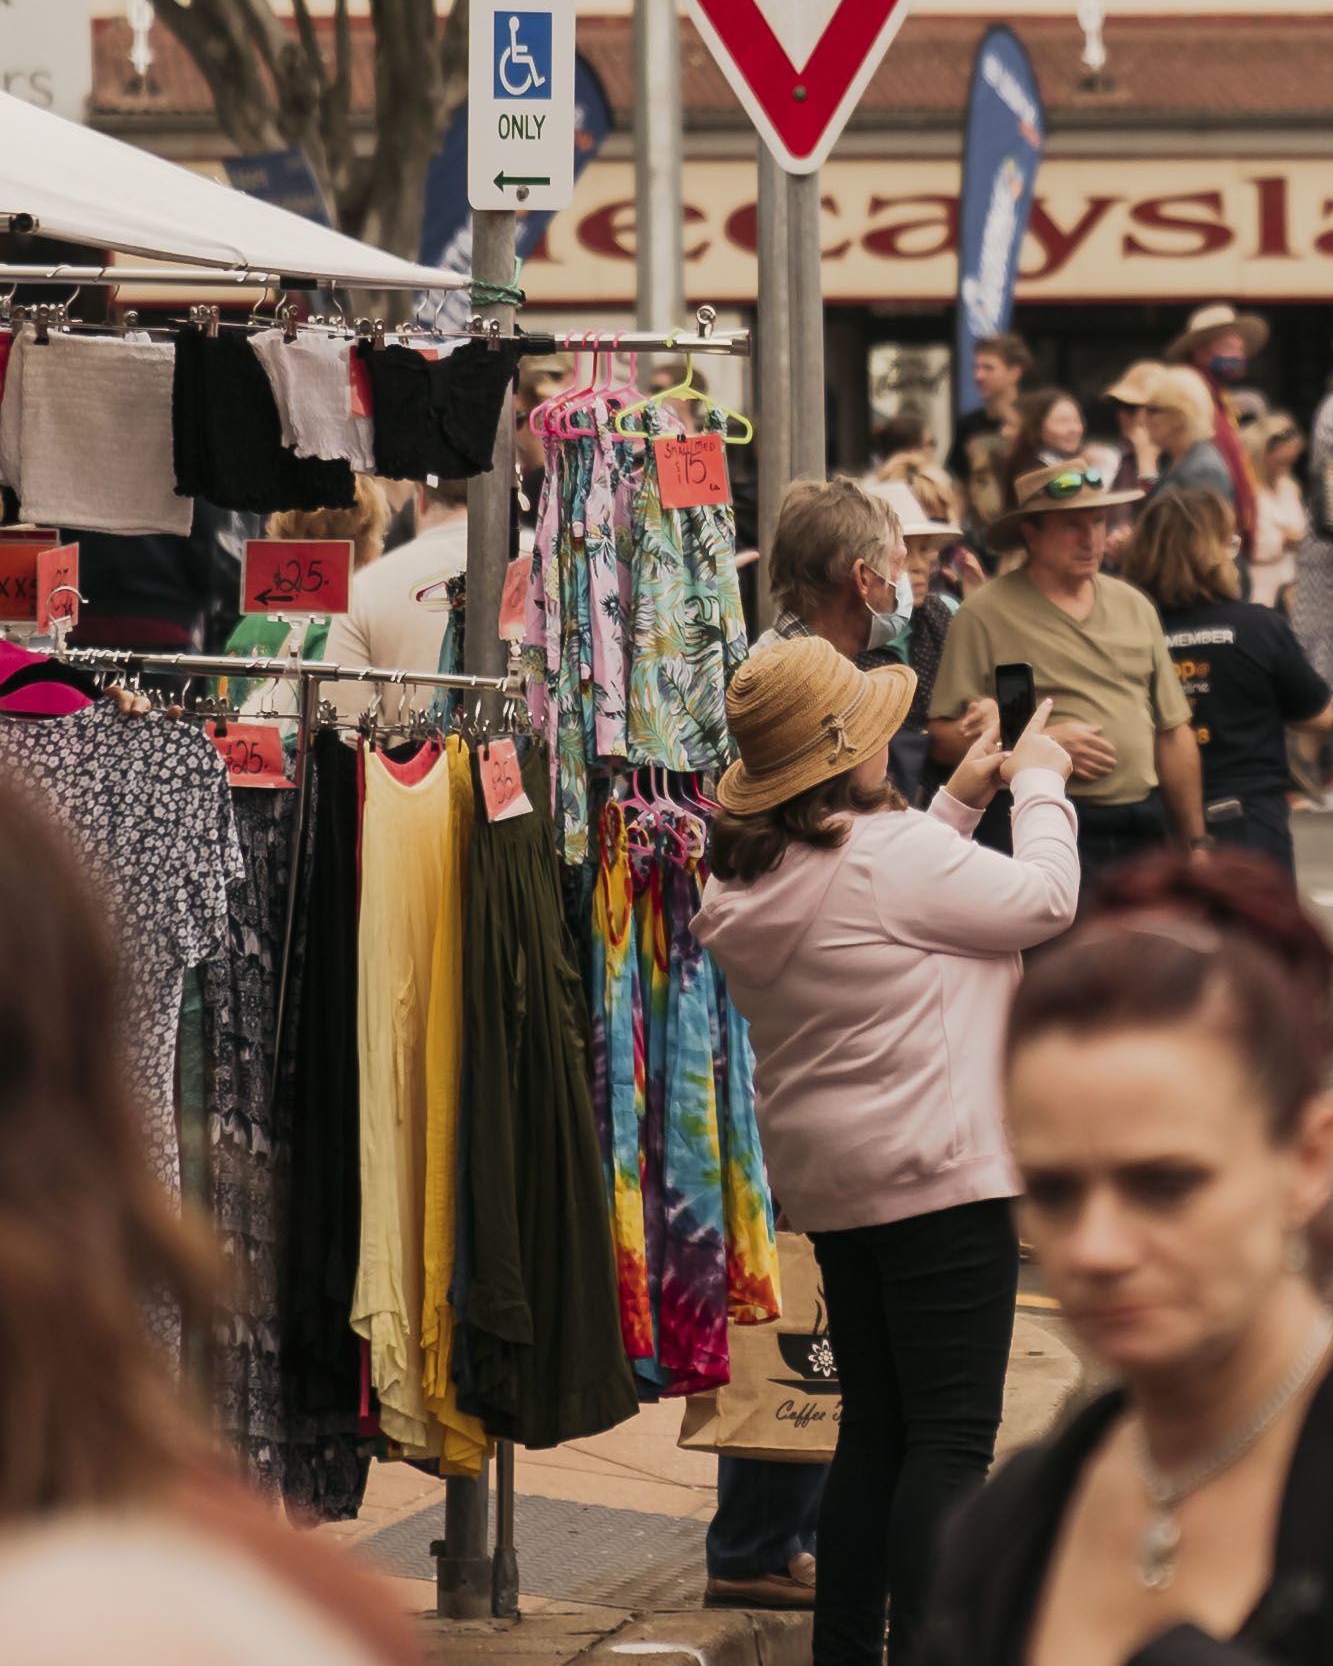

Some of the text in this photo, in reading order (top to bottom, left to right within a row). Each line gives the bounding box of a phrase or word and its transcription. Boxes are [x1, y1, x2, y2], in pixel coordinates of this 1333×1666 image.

[498, 114, 546, 140] ONLY
[1166, 628, 1234, 648] MEMBER
[775, 1399, 827, 1429] Coffee
